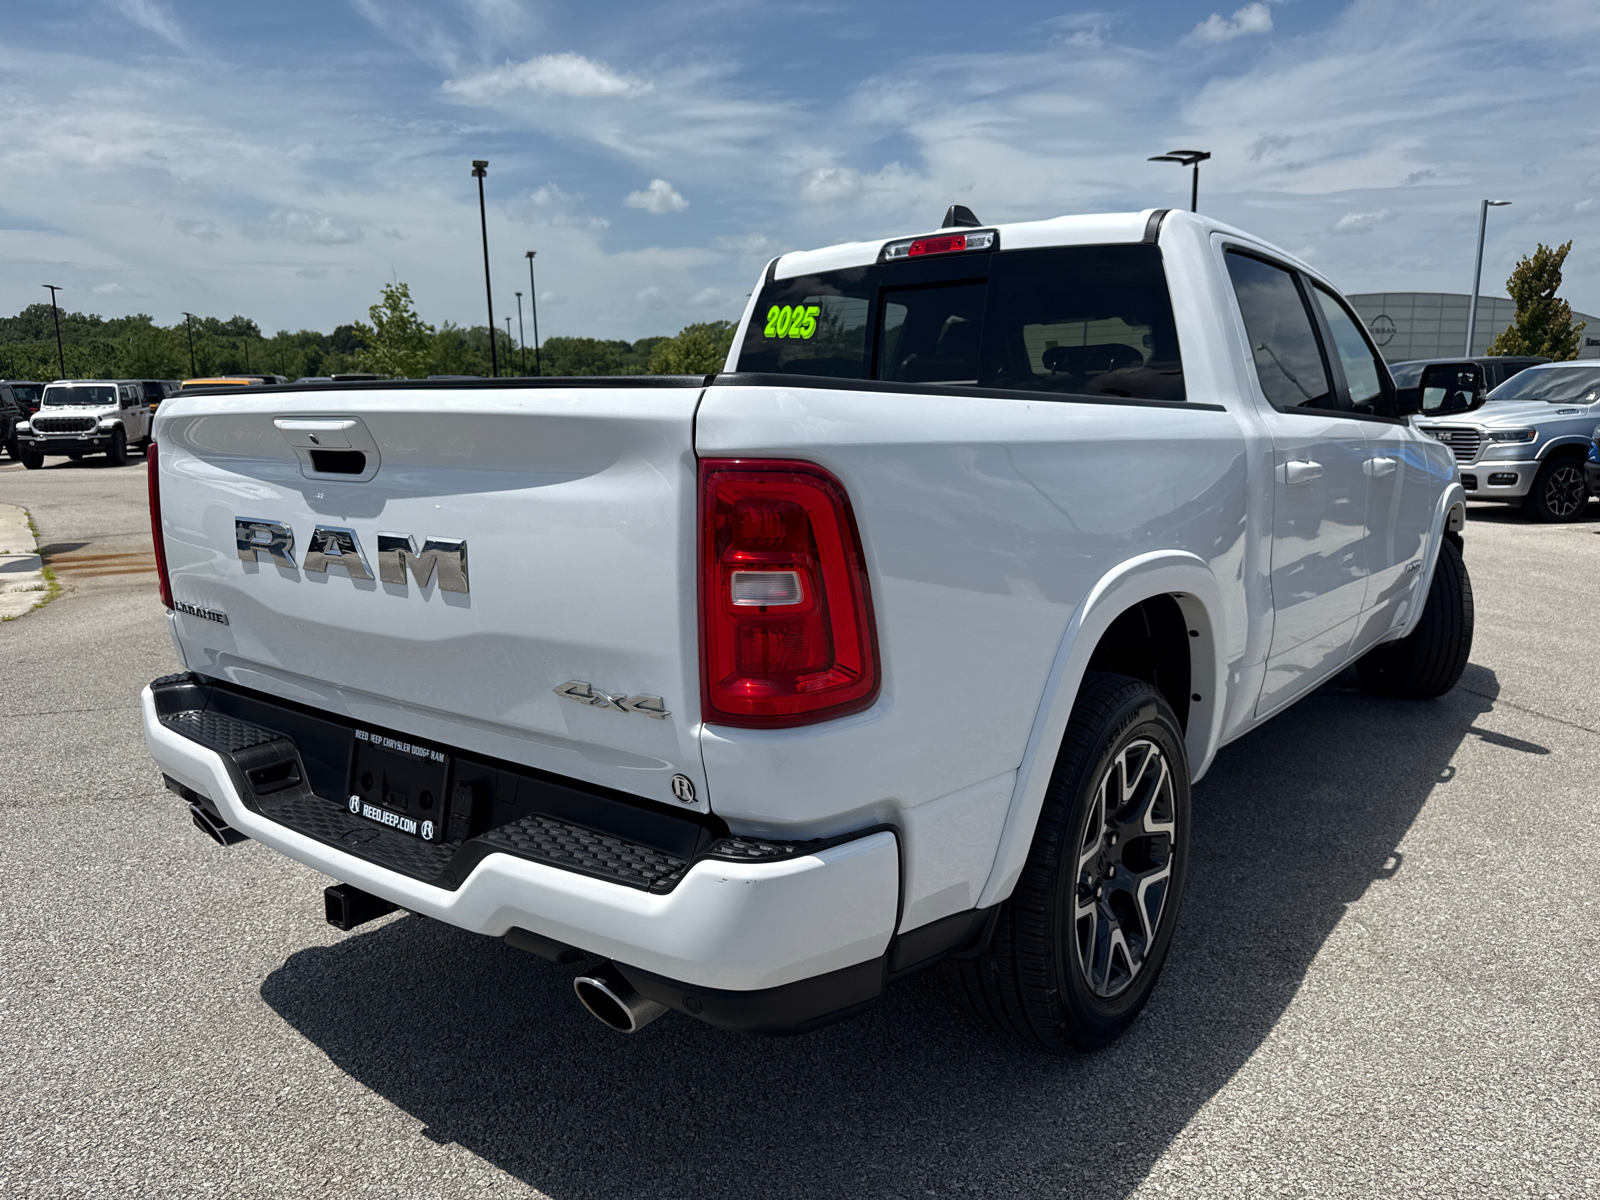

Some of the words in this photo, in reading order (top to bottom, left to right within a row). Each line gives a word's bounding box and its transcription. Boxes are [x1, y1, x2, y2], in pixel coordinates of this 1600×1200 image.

[764, 305, 820, 340] 2025
[235, 516, 469, 593] RAM
[175, 600, 226, 624] LARAMIE
[1109, 707, 1140, 749] SAILUN
[355, 729, 369, 741] REED
[370, 733, 383, 745] JEEP
[383, 737, 411, 754] CHRYSLER
[430, 751, 445, 763] RAM
[362, 804, 417, 834] REEDJEEP.COM
